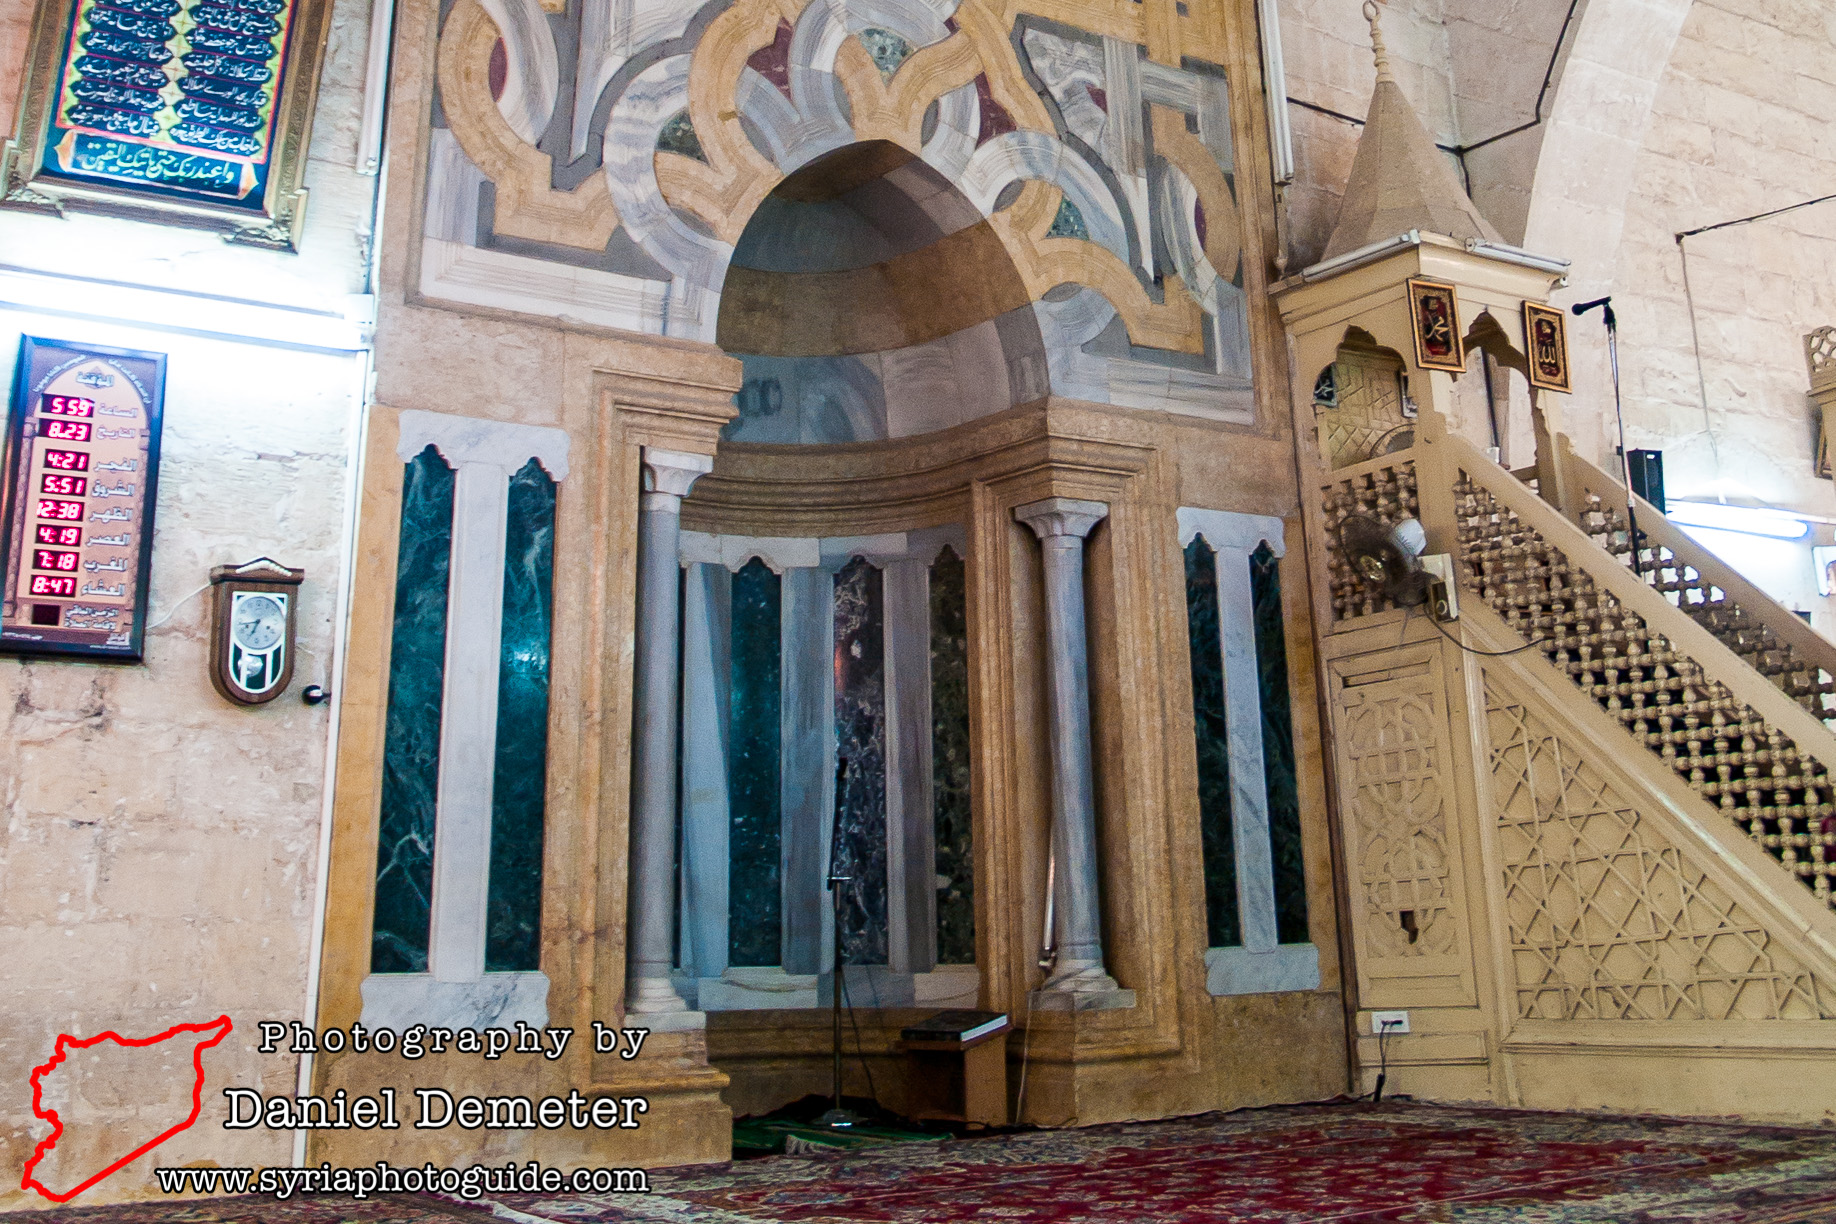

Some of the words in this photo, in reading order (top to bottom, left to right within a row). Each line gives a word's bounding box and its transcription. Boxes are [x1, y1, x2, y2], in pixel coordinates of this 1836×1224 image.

[98, 403, 138, 418] الساعة
[47, 451, 87, 470] 4:21
[94, 457, 137, 473] الفجر
[44, 475, 84, 494] 5:51
[91, 479, 135, 498] الشروق
[36, 500, 82, 519] 12:38
[88, 506, 133, 523] الظهر
[38, 527, 79, 545] 4:19
[85, 533, 131, 547] العصر
[38, 551, 77, 570] 7:18
[83, 556, 128, 573] المغرب
[32, 576, 74, 594] 8:47
[81, 579, 125, 596] العشاء
